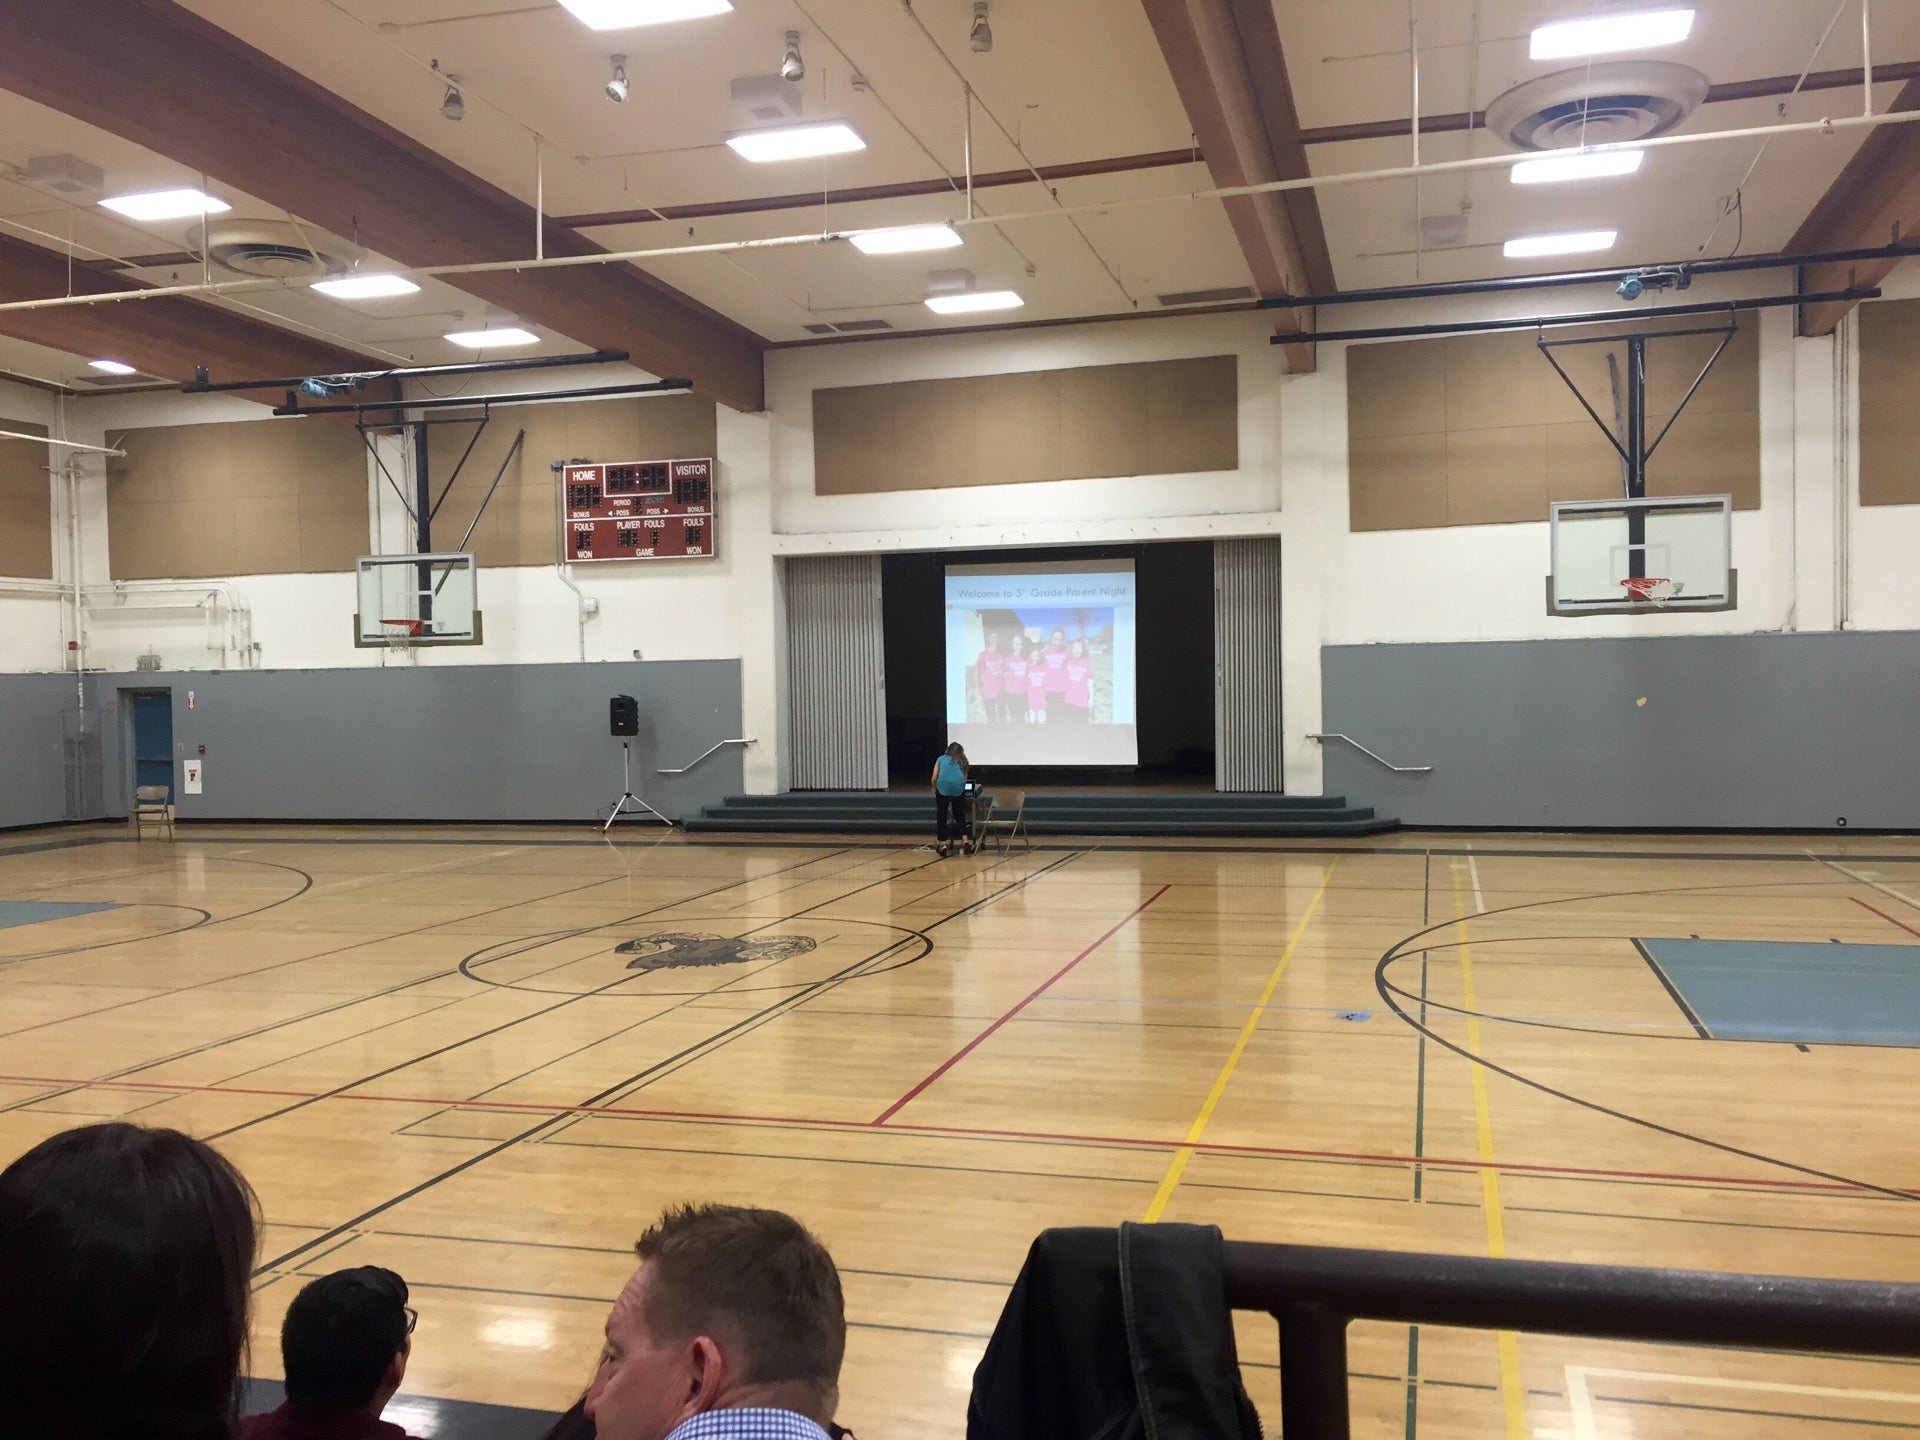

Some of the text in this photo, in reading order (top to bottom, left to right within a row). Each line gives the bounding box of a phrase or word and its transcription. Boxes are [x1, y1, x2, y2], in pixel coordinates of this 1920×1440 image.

[676, 465, 707, 476] VISITOR
[573, 471, 595, 481] HOME
[574, 523, 595, 531] FOULS
[617, 520, 665, 529] PLAYER FOULS
[683, 518, 704, 527] FOULS
[577, 550, 592, 559] WON
[636, 548, 654, 556] GAME
[686, 546, 702, 555] WON
[957, 589, 1000, 598] Welcome
[1003, 589, 1012, 597] to
[1031, 587, 1062, 598] Grade
[1066, 586, 1097, 597] Parent
[1099, 585, 1126, 598] Night
